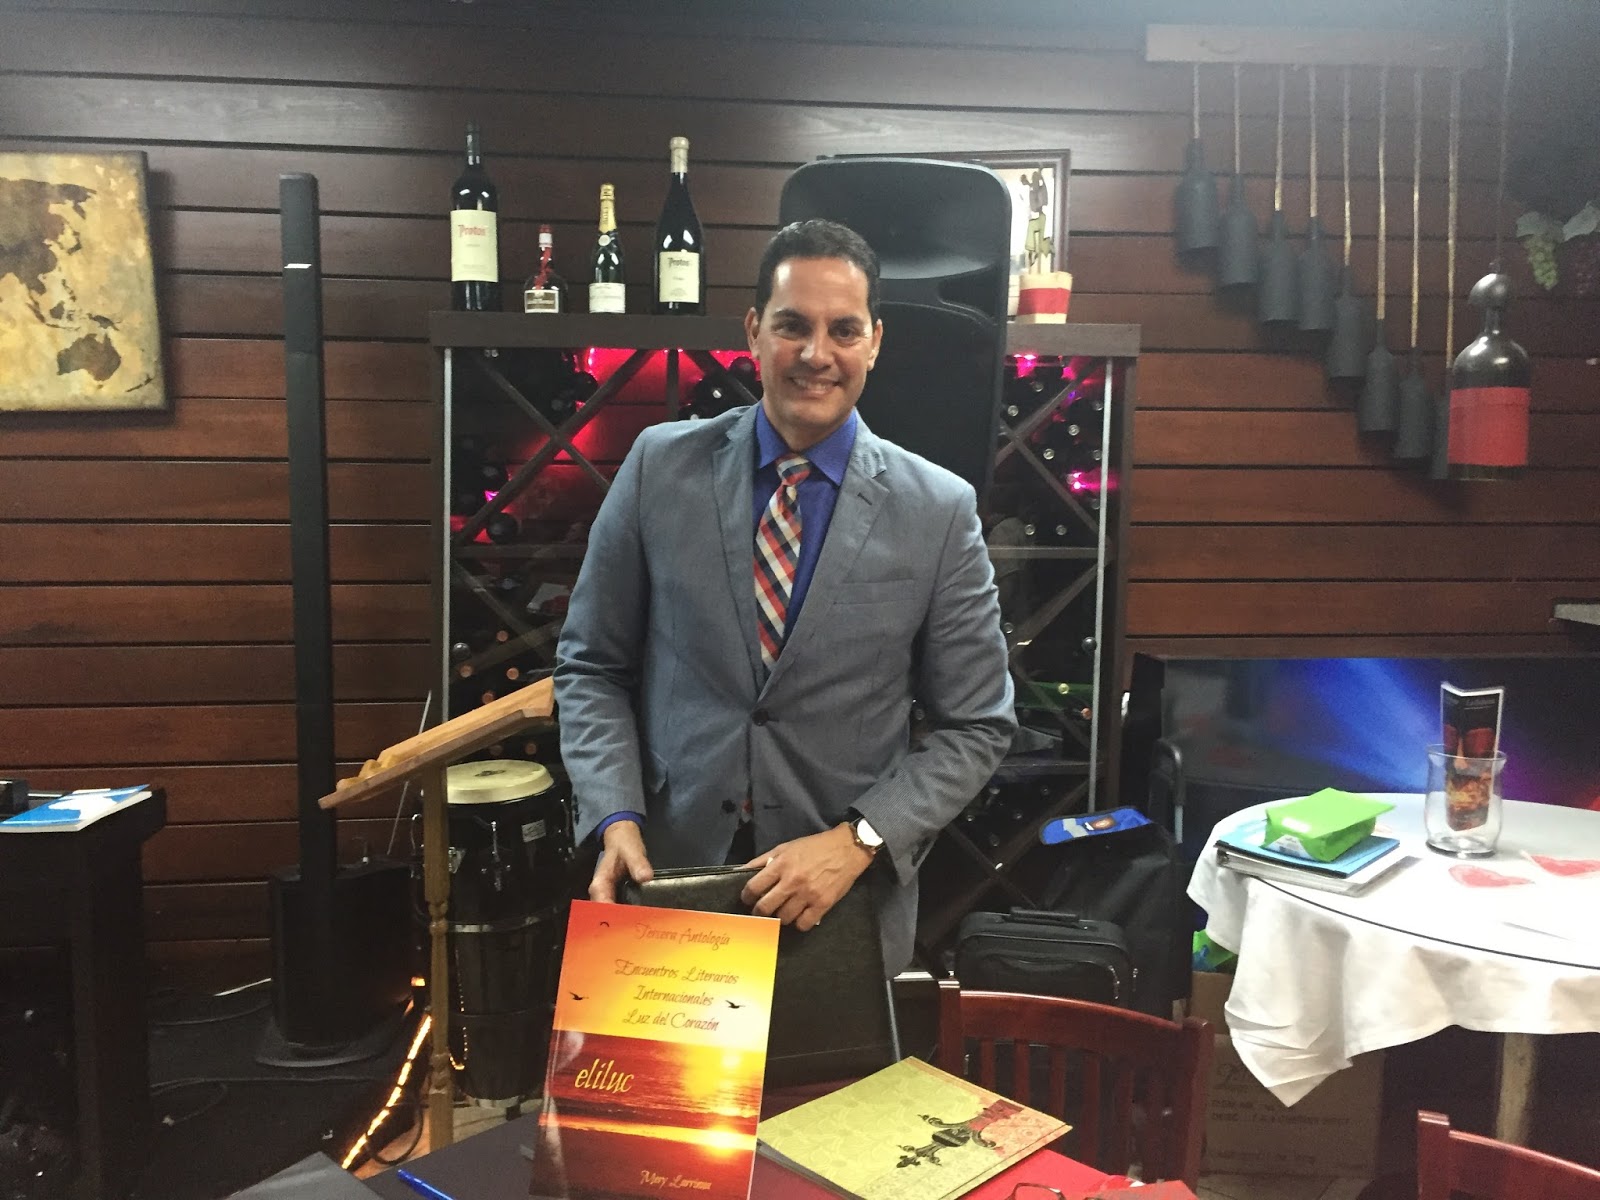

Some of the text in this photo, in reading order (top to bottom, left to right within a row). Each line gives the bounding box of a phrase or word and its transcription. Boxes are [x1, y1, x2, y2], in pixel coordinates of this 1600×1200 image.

[635, 922, 678, 940] Tercera
[614, 958, 740, 984] Encuentros Literarios
[633, 984, 715, 1006] Internacionales
[622, 1008, 720, 1031] Luz del Corazón
[574, 1058, 635, 1094] eliluc
